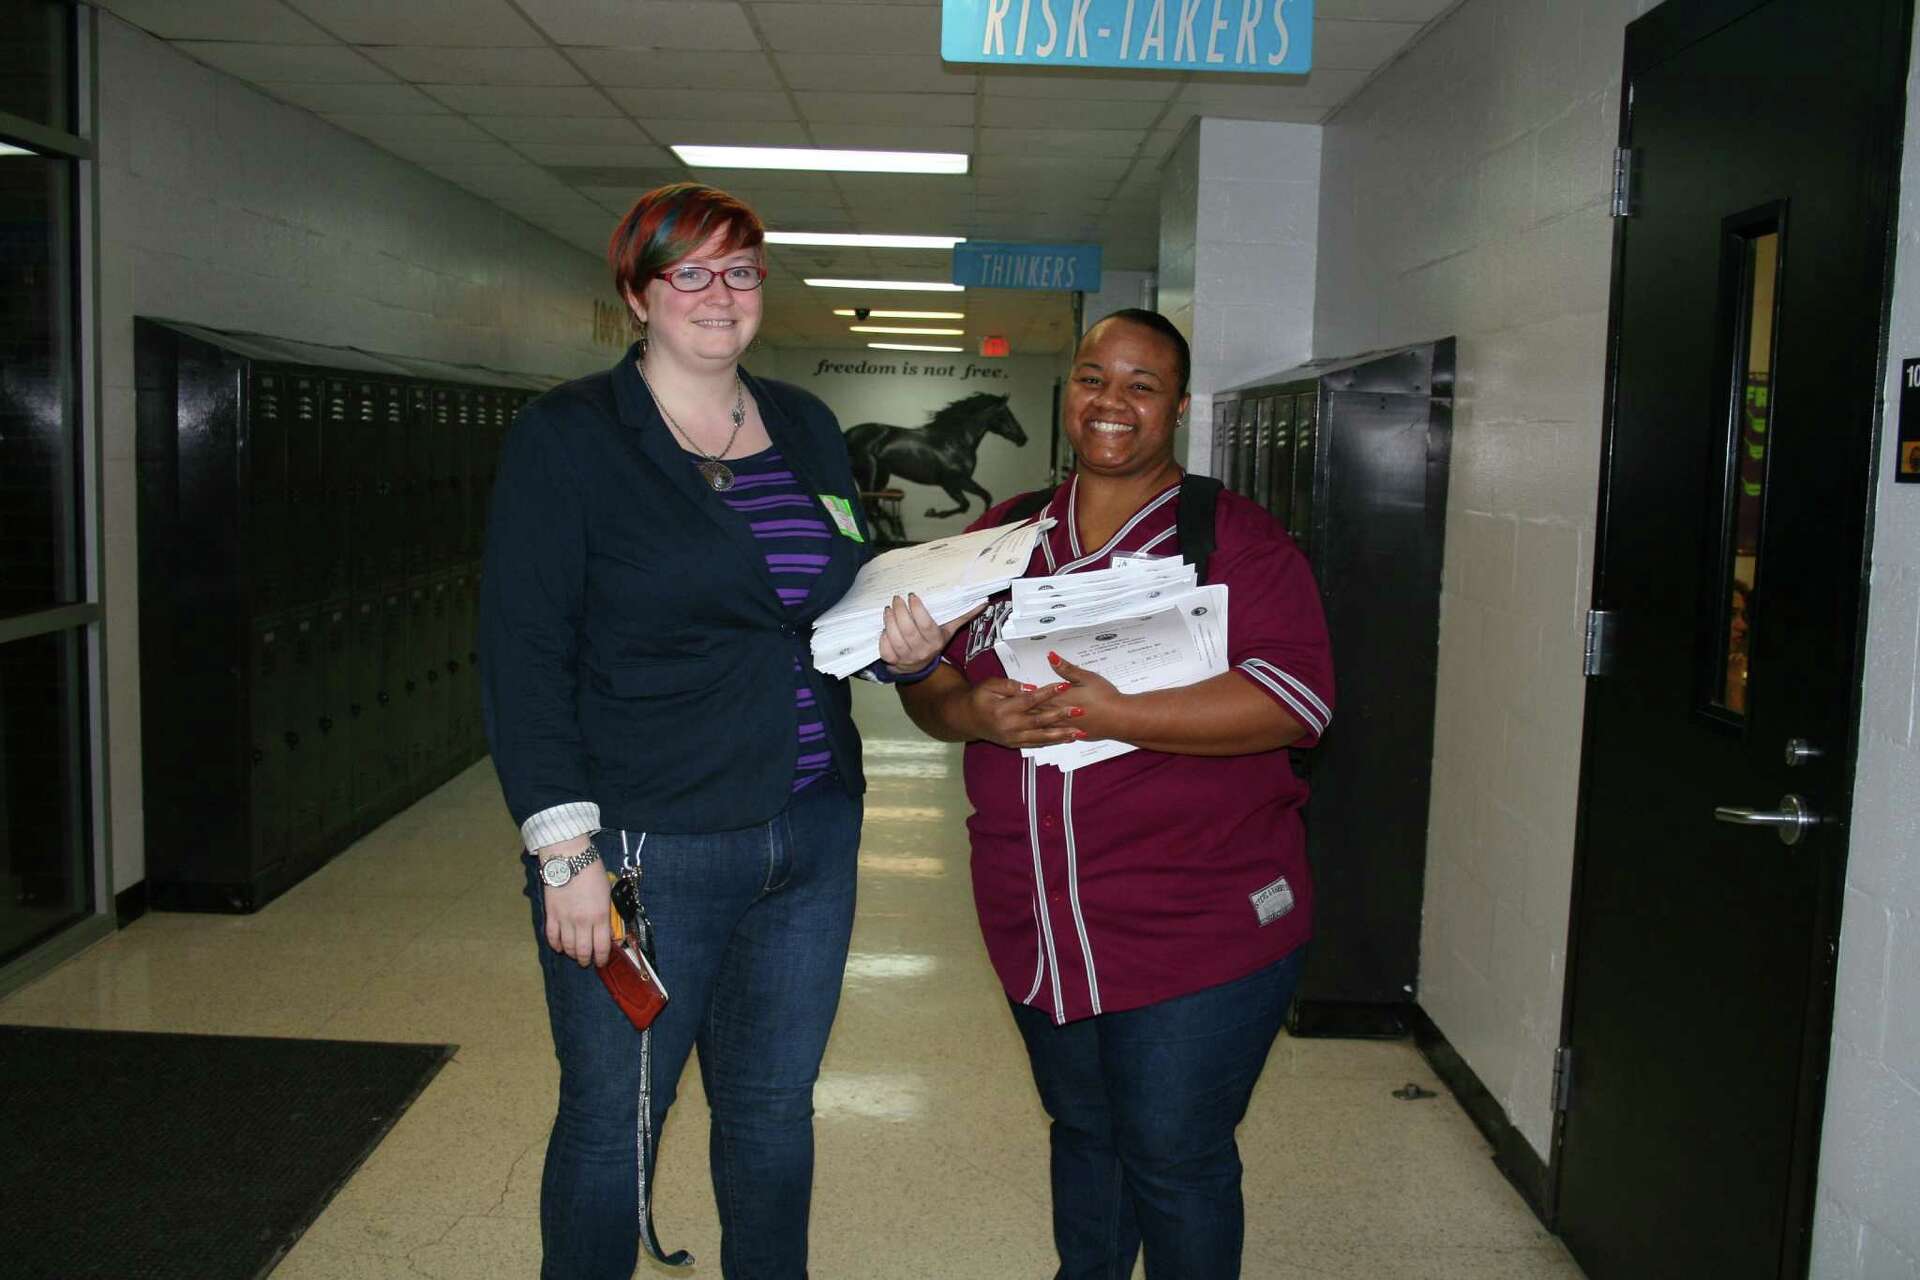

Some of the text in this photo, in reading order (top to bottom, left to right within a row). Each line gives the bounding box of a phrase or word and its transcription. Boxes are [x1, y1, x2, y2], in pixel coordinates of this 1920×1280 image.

[982, 0, 1295, 65] RISK-TAKERS
[981, 254, 1077, 288] THINKERS
[813, 359, 1009, 380] freedom is not free.
